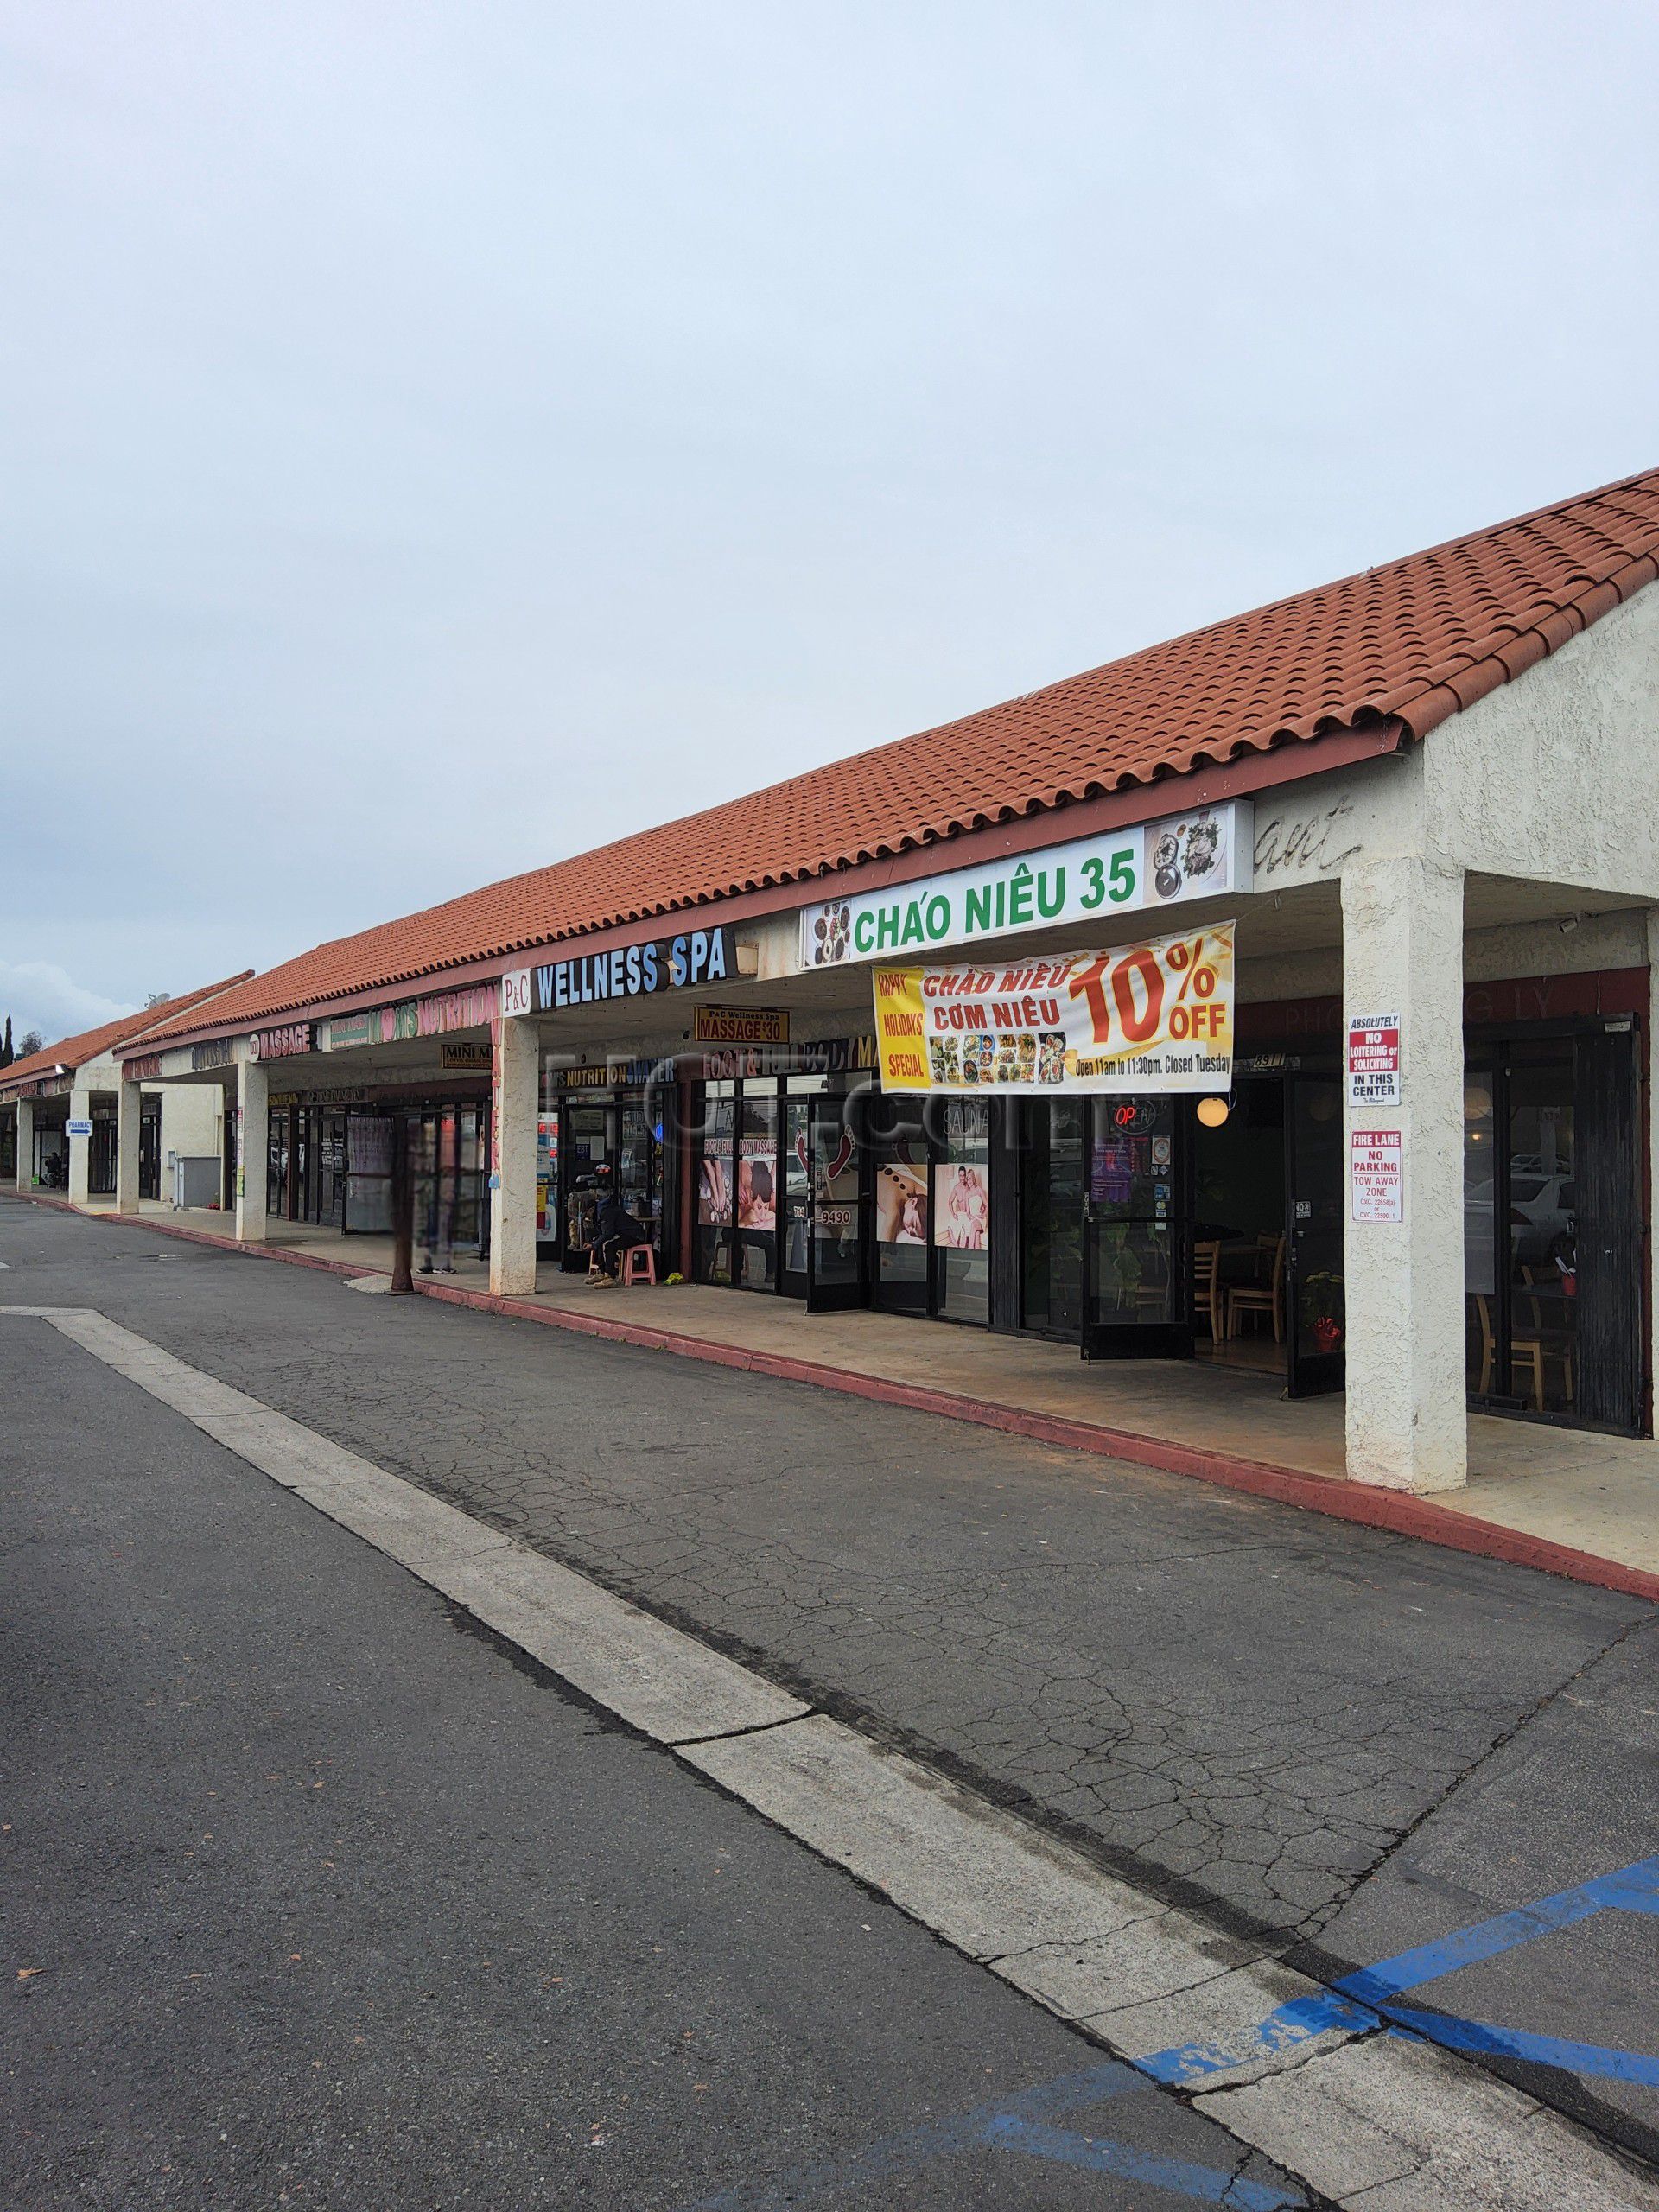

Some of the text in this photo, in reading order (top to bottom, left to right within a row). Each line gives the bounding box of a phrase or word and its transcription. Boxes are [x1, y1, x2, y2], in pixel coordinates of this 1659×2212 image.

[855, 849, 1135, 953] CHÁO NIÊU 35
[505, 927, 726, 1011] P&C WELLNESS SPA
[998, 963, 1071, 992] NIÊU
[878, 973, 907, 996] HAPPY
[1069, 938, 1215, 1044] 10%
[418, 980, 498, 1036] NUTRITION
[709, 1010, 780, 1021] P&C Wellness Spa
[934, 995, 1060, 1030] CƠM NIÊU
[700, 1018, 780, 1040] MASSAGE $30
[884, 1013, 923, 1037] HOLIDAYS
[1169, 1003, 1225, 1039] OFF
[1351, 1015, 1398, 1028] ABSOLUTELY
[260, 1024, 310, 1059] MASSAGE
[1365, 1032, 1382, 1044] NO
[447, 1046, 475, 1058] MINI
[1255, 1053, 1284, 1066] 8911
[1350, 1045, 1397, 1058] LOITERING or
[889, 1053, 924, 1077] SPECIAL
[1076, 1052, 1230, 1077] Open 11am to 11:30pm. Closed Tuesday
[1353, 1058, 1394, 1071] SOLICITING
[567, 1065, 627, 1087] NUTRITION
[1354, 1073, 1393, 1084] IN THIS
[1353, 1085, 1395, 1096] CENTER
[943, 1109, 988, 1135] SAUNA
[739, 1138, 753, 1155] BODY
[753, 1138, 778, 1154] MASSAGE
[1353, 1134, 1400, 1146] FIRE LANE
[576, 1145, 588, 1154] EBT
[1368, 1150, 1382, 1160] NO
[1354, 1162, 1397, 1172] PARKING
[1354, 1176, 1398, 1185] TOW AWAY
[1366, 1187, 1387, 1197] ZONE
